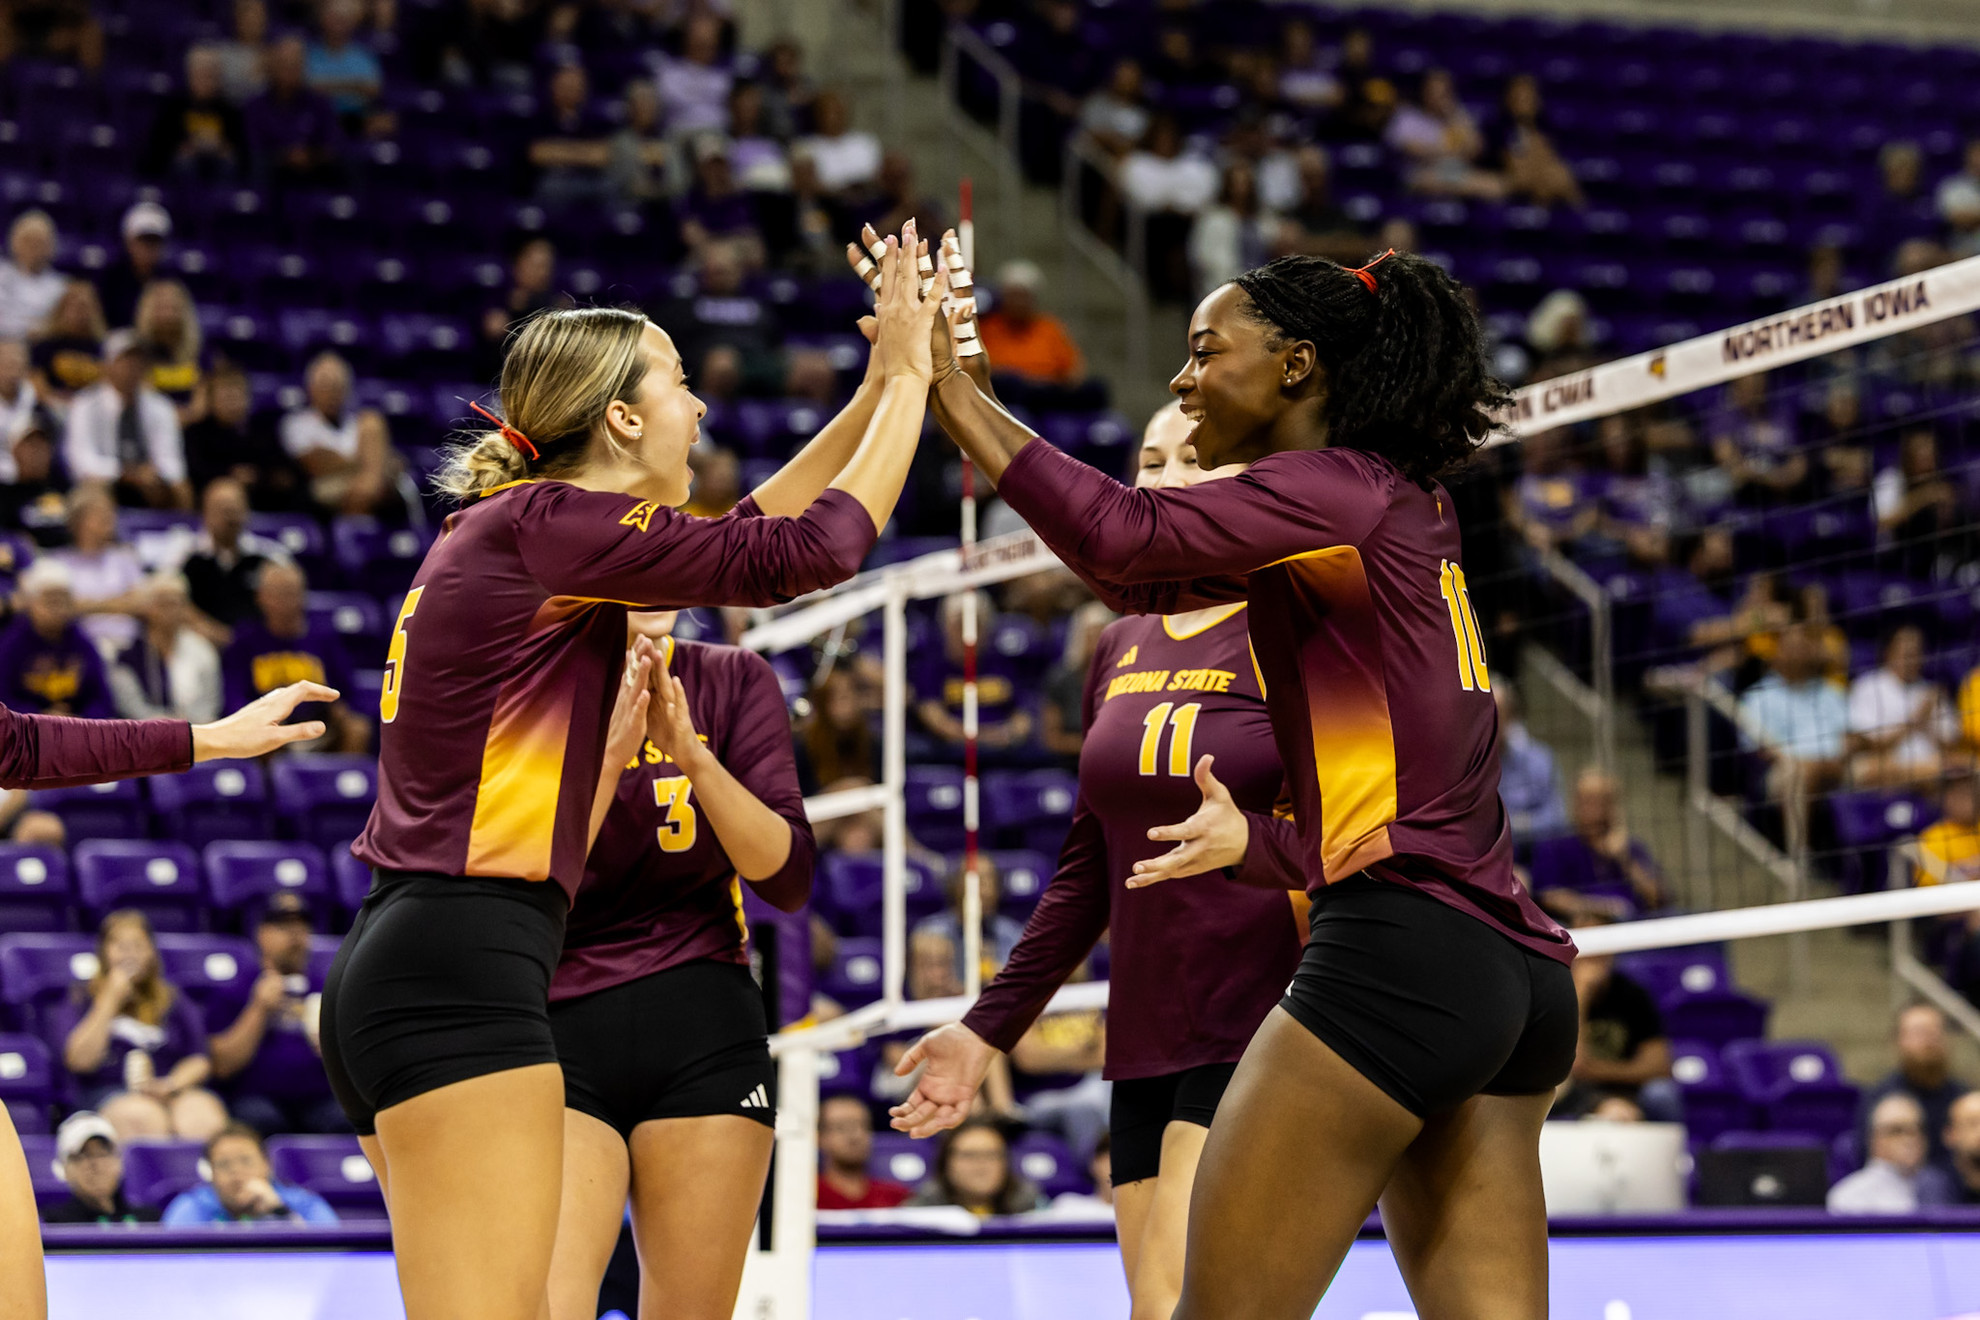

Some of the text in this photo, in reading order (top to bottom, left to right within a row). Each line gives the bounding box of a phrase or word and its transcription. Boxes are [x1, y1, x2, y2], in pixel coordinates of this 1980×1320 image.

[1723, 281, 1931, 362] NORTHERN IOWA
[379, 584, 426, 724] 5
[1439, 558, 1491, 693] 10
[1104, 668, 1237, 703] RIZONA STATE
[1138, 702, 1202, 777] 11
[652, 775, 697, 853] 3
